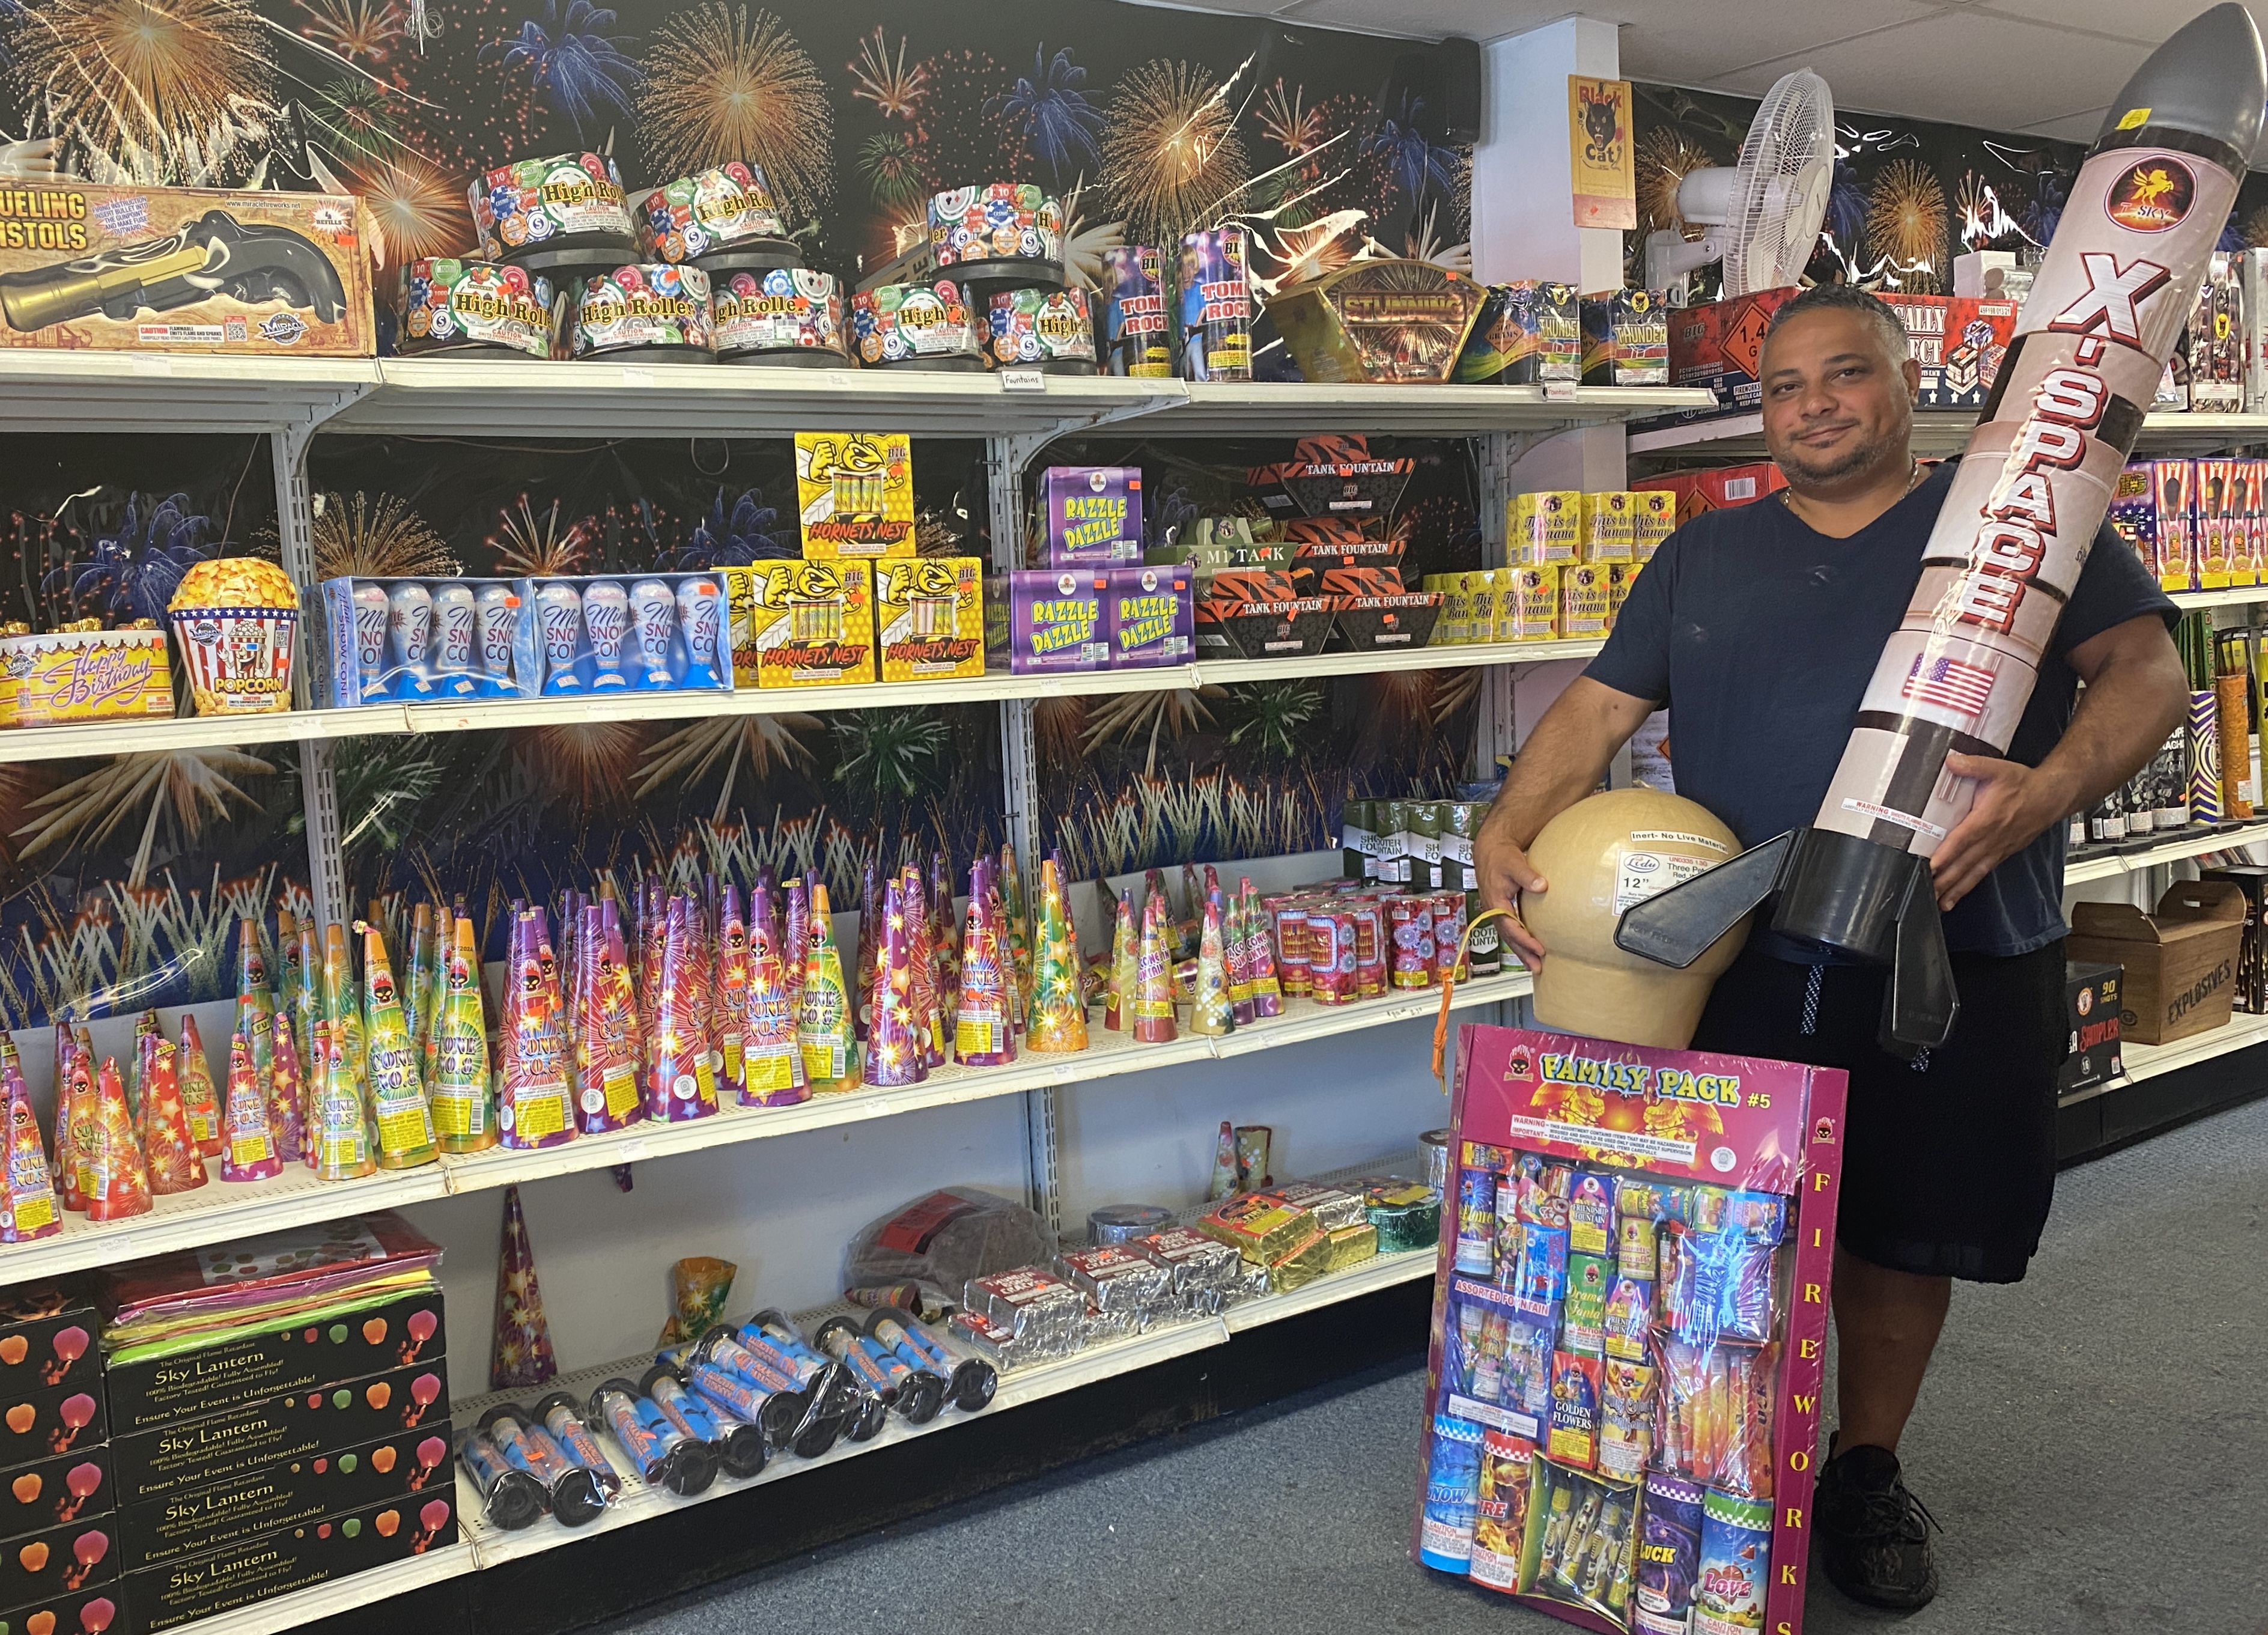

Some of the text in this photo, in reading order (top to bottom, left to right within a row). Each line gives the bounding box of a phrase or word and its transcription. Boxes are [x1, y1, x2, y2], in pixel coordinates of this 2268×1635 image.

[1579, 85, 1622, 108] Black
[1585, 143, 1614, 163] Cat
[494, 171, 505, 183] 10
[543, 180, 594, 204] High
[999, 188, 1009, 196] 10
[93, 196, 147, 213] FIRING INSTRUCTION
[95, 210, 114, 219] INSERT
[115, 206, 135, 215] BULLET
[226, 199, 301, 209] www.miraclefireworks.net
[696, 196, 747, 221] High
[105, 210, 143, 224] THE GUNPOINT
[114, 224, 142, 235] OUTWARD
[416, 264, 425, 273] 10
[454, 293, 510, 318] High
[743, 296, 804, 314] Roller
[858, 296, 868, 305] 10
[581, 300, 627, 326] High
[898, 306, 945, 327] High
[492, 329, 522, 338] CAUTION
[613, 327, 643, 336] CAUTION
[726, 322, 753, 330] CAUTION
[1039, 317, 1078, 337] High
[1489, 330, 1519, 341] GRAMS
[1615, 324, 1667, 344] THUNDER
[1684, 323, 1705, 338] BIG
[1740, 321, 1765, 343] 1.4
[1748, 346, 1757, 357] G
[1005, 375, 1039, 385] Fountains
[1735, 383, 1760, 394] FIREWORKS
[1306, 461, 1395, 475] TANK FOUNTAIN
[1064, 497, 1127, 519] RAZZLE
[809, 521, 913, 541] HORNETS NEST
[1063, 517, 1120, 551] DAZZLE
[1206, 550, 1229, 564] M1
[1312, 543, 1388, 556] TANK FOUNTAIN
[844, 571, 863, 583] BIG
[958, 570, 975, 581] BIG
[1355, 595, 1430, 608] TANK FOUNTAIN
[1532, 591, 1542, 601] is
[1032, 598, 1098, 624] RAZZLE
[1119, 594, 1178, 621] RAZZLE
[1242, 600, 1322, 615] TANK FOUNTAIN
[1030, 620, 1090, 655] DAZZLE
[1118, 614, 1173, 652] DAZZLE
[339, 615, 349, 699] SNOW CONE
[762, 645, 871, 668] HORNETS NEST
[886, 639, 980, 662] HORNETS NEST
[42, 642, 127, 691] Happy
[72, 657, 153, 710] Birthday
[214, 677, 283, 694] POPCORN
[1856, 801, 1889, 815] WARNING
[1698, 837, 1728, 853] Material
[1667, 862, 1690, 872] Three
[1245, 931, 1267, 949] CONE
[2103, 979, 2115, 995] 90
[2168, 959, 2231, 1025] EXPLOSIVES
[2100, 994, 2118, 1003] SHOTS
[744, 999, 788, 1018] CONE
[748, 1018, 786, 1037] NO.8
[2080, 1017, 2119, 1053] SAMPLER
[439, 1034, 477, 1055] CONE
[514, 1034, 562, 1058] CONE
[371, 1047, 416, 1072] CONE
[437, 1054, 473, 1076] NO.8
[517, 1056, 559, 1077] NO.8
[375, 1070, 418, 1091] NO.8
[1539, 1052, 1772, 1109] FAMILY PACK #5
[228, 1097, 260, 1114] CONE
[323, 1097, 354, 1112] CONE
[1512, 1126, 1545, 1137] IMPORTANT
[1561, 1135, 1582, 1145] CAUTIONS
[1590, 1140, 1616, 1149] INDIVIDUAL
[1631, 1146, 1658, 1156] CAREFULLY.
[1513, 1116, 1545, 1128] WARNING
[1560, 1124, 1589, 1134] ASSORTMENT
[1590, 1128, 1612, 1137] CONTAINS
[1657, 1140, 1685, 1149] HAZARDOUS
[1579, 1133, 1598, 1142] SHOULD
[1617, 1138, 1629, 1146] ONLY
[1629, 1140, 1645, 1149] UNDER
[1661, 1145, 1693, 1156] SUPERVISION.
[11, 1157, 47, 1174] CONE
[1572, 1203, 1610, 1216] FRIENDSHIP
[1573, 1213, 1607, 1224] FOUNTAIN
[1157, 1236, 1205, 1252] CRACKER
[1084, 1254, 1136, 1270] CRACKER
[1455, 1279, 1551, 1316] ASSORTED FONTAIN
[159, 1359, 173, 1368] The
[174, 1354, 201, 1365] Original
[224, 1344, 255, 1354] Retardant
[154, 1351, 264, 1386] Sky Lantern
[145, 1387, 166, 1398] 100%
[223, 1370, 242, 1380] Fully
[243, 1359, 284, 1374] Assembled!
[154, 1390, 181, 1404] Factory
[183, 1385, 210, 1396] Tested!
[211, 1375, 255, 1390] Guaranteed
[264, 1368, 279, 1379] Fly!
[135, 1411, 170, 1425] Ensure
[172, 1405, 197, 1417] Your
[200, 1397, 230, 1410] Event
[243, 1374, 315, 1399] Unforgettable!
[1776, 1173, 1831, 1635] FIREWORKS
[1555, 1401, 1592, 1418] GOLDEN
[1552, 1413, 1592, 1429] FLOWERS
[159, 1417, 268, 1454] Sky Lantern
[1607, 1439, 1635, 1449] CAUTION
[139, 1479, 174, 1494] Ensure
[177, 1473, 201, 1485] Your
[204, 1465, 234, 1478] Event
[247, 1440, 319, 1466] Unforgettable!
[165, 1484, 274, 1522] Sky Lantern
[1426, 1482, 1468, 1505] SNOW
[1429, 1521, 1457, 1533] CAUTION
[1473, 1545, 1497, 1559] CAUTION
[169, 1549, 278, 1589] Sky Lantern
[1703, 1572, 1754, 1598] LOVE
[1707, 1618, 1742, 1634] CAUTION
